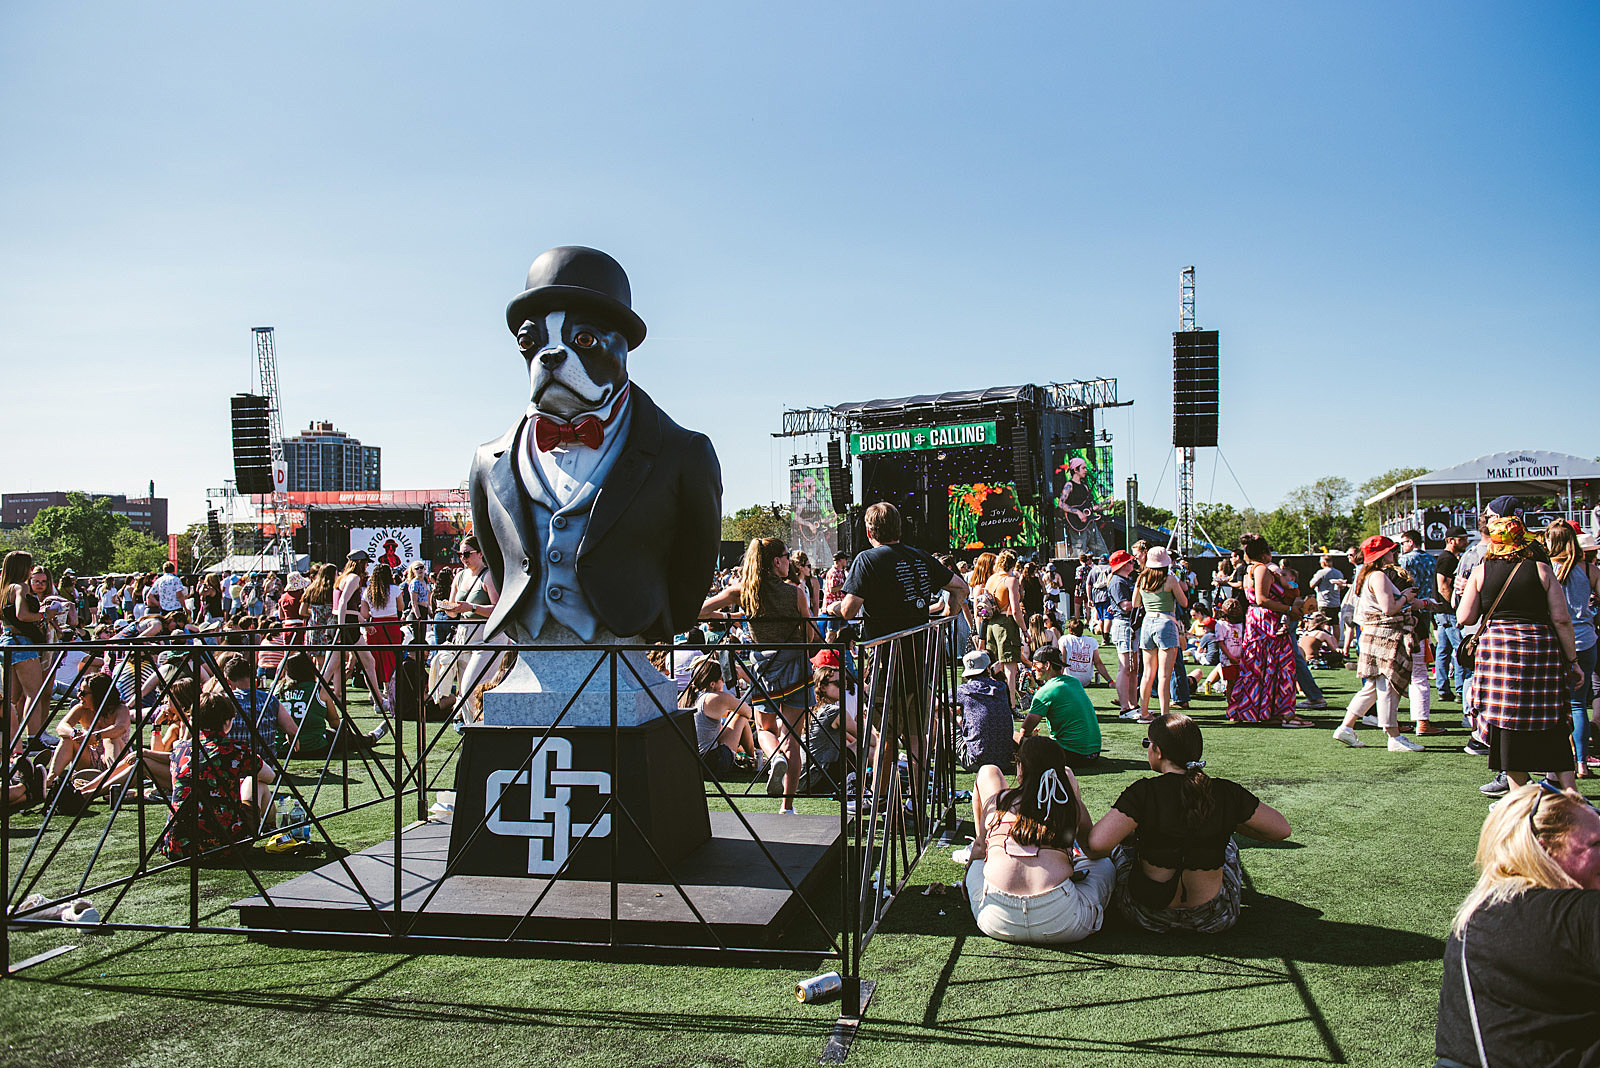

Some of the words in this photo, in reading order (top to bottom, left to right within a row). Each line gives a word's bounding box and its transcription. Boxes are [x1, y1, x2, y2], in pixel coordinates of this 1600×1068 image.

[859, 432, 911, 452] BOSTON
[930, 425, 985, 446] CALLING
[277, 469, 285, 484] D
[1487, 468, 1513, 479] MAKE
[1516, 467, 1525, 478] IT
[1527, 465, 1559, 477] COUNT
[990, 508, 1006, 517] JOY
[367, 529, 389, 558] BOSTON
[391, 529, 414, 558] CALLING
[284, 689, 305, 700] BIRD
